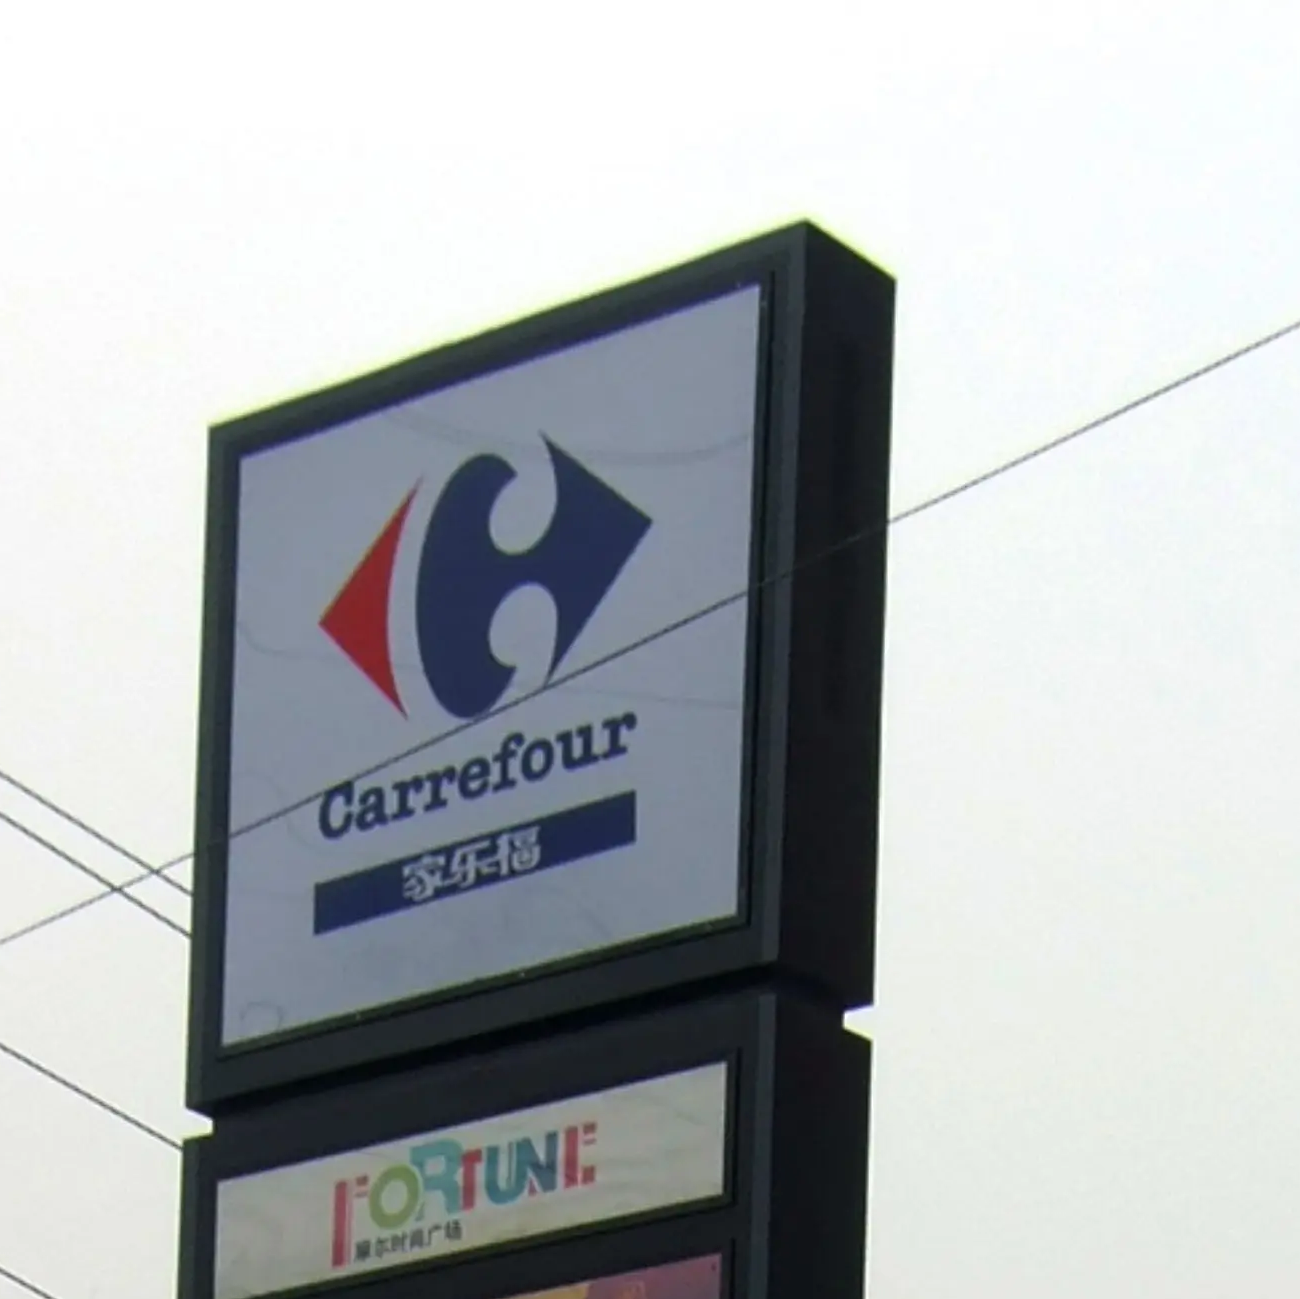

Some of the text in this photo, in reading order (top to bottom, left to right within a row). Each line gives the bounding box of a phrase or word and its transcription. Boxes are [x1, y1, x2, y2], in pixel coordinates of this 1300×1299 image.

[317, 711, 638, 840] Carrefour
[402, 825, 542, 902] 家乐福
[330, 1121, 598, 1270] FORTUNE
